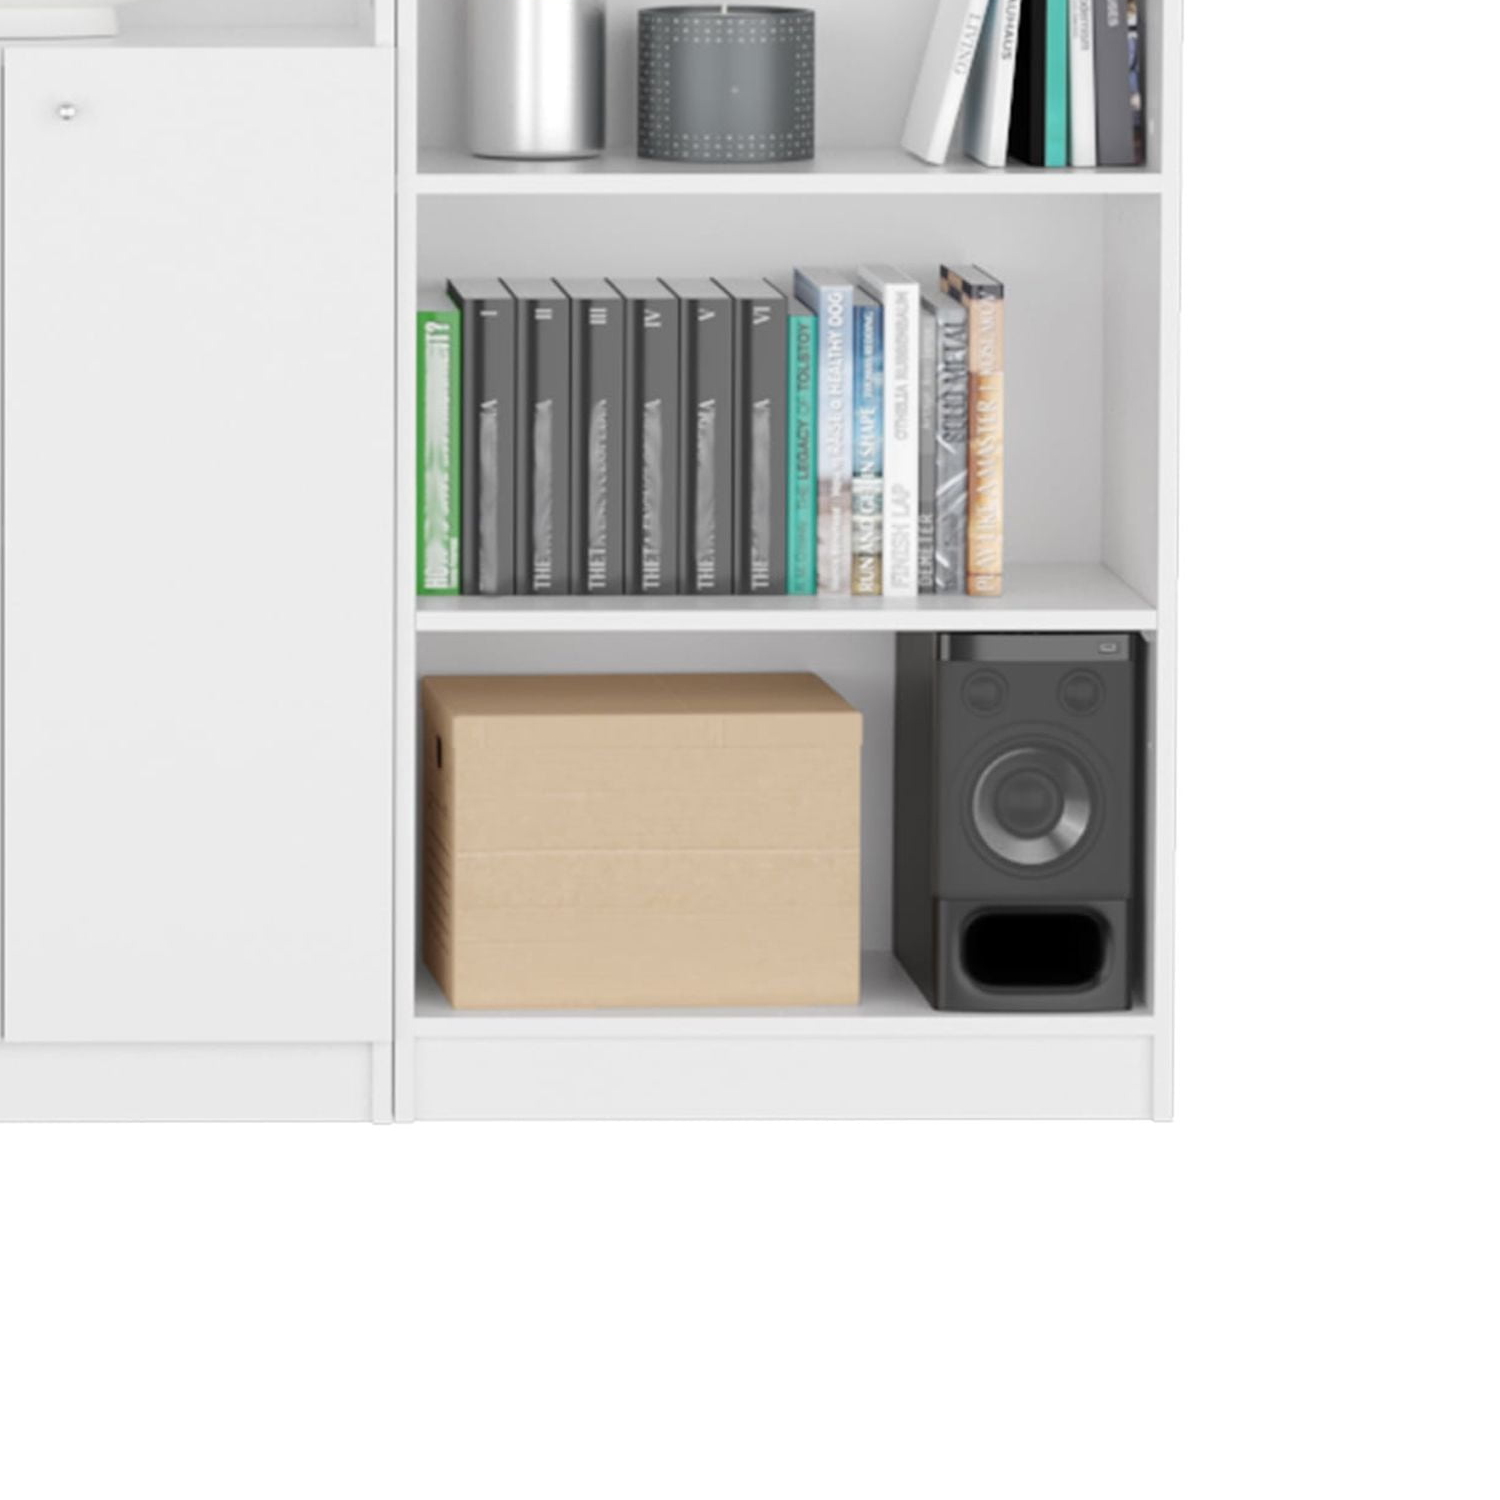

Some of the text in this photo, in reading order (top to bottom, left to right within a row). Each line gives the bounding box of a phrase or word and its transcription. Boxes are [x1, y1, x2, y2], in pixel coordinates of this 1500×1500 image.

[953, 12, 982, 77] LIVING
[534, 307, 553, 321] II
[589, 307, 607, 325] III
[643, 308, 662, 328] IV
[697, 307, 716, 323] V
[752, 305, 771, 325] VI
[826, 292, 844, 328] DOG
[797, 323, 810, 392] TOLSTOY
[859, 406, 876, 457] SHAPE
[797, 421, 810, 481] LEGACY
[890, 483, 910, 518] LAP
[859, 517, 876, 554] AND
[890, 523, 910, 589] FINISH
[859, 557, 876, 592] RUN
